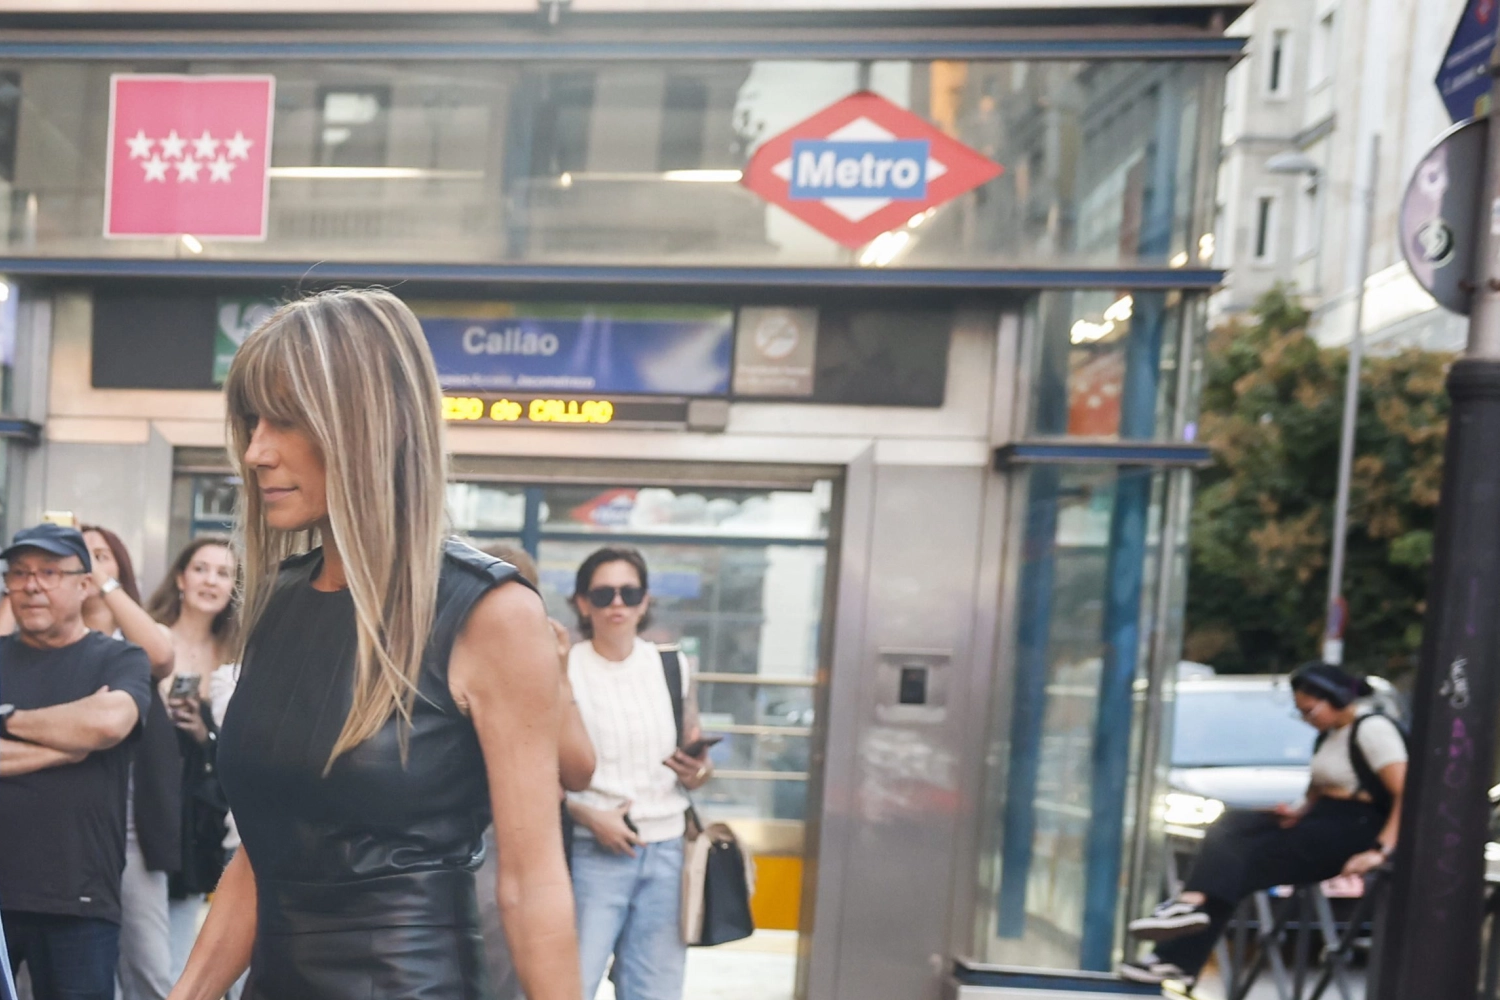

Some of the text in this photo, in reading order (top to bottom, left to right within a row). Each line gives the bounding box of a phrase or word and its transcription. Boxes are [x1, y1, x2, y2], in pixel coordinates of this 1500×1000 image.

[797, 151, 920, 189] Metro
[462, 326, 559, 356] Callao
[490, 398, 522, 421] de
[528, 398, 614, 424] CALLAO
